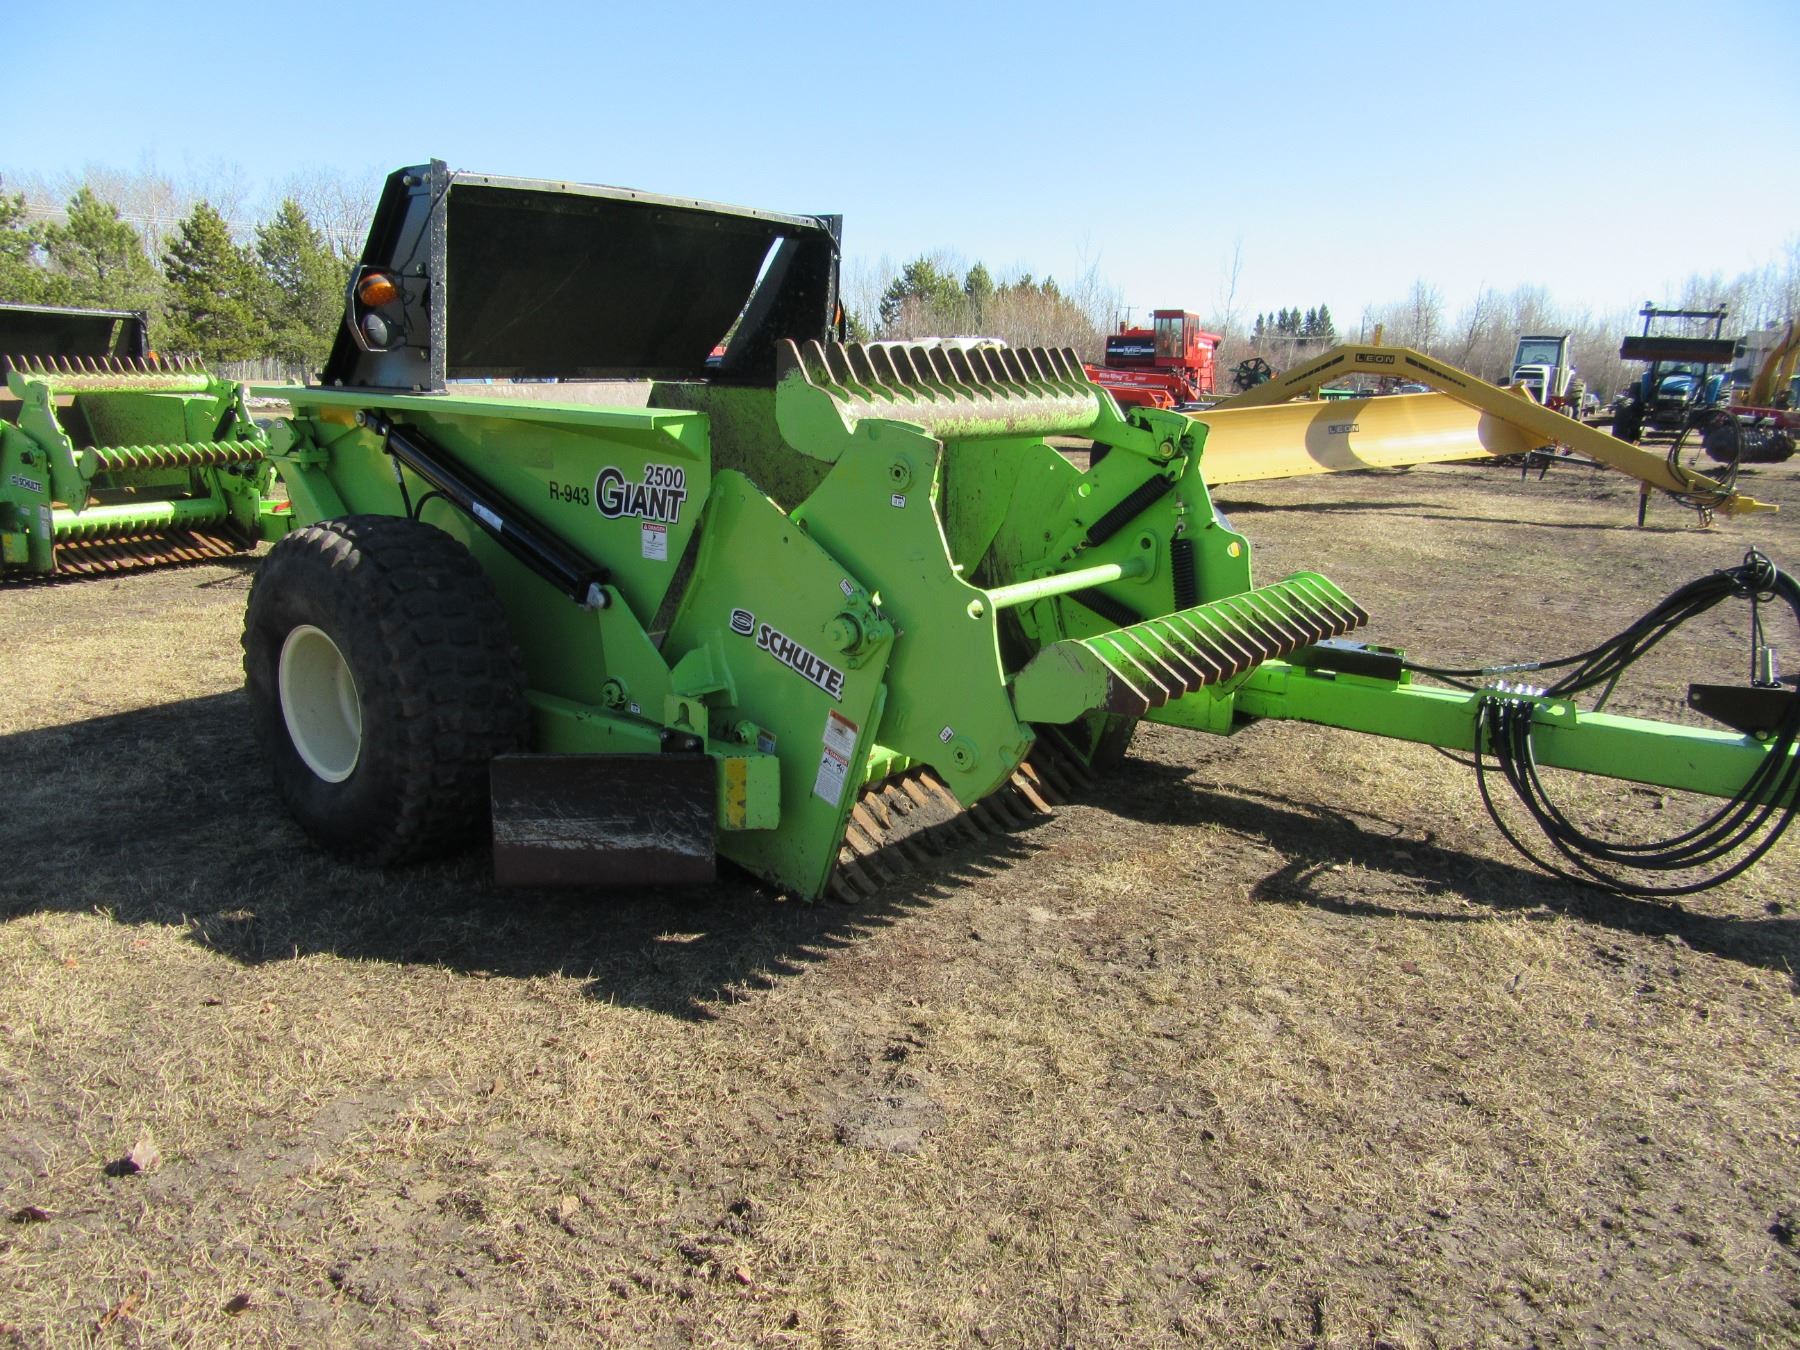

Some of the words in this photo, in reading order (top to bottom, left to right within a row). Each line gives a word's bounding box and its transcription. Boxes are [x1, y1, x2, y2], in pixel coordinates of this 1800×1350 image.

[1356, 353, 1394, 363] LEON
[1329, 424, 1359, 433] LEON
[645, 465, 684, 488] 2500
[549, 481, 589, 506] R-943
[596, 467, 686, 522] GIANT
[757, 624, 842, 693] SCHULTE
